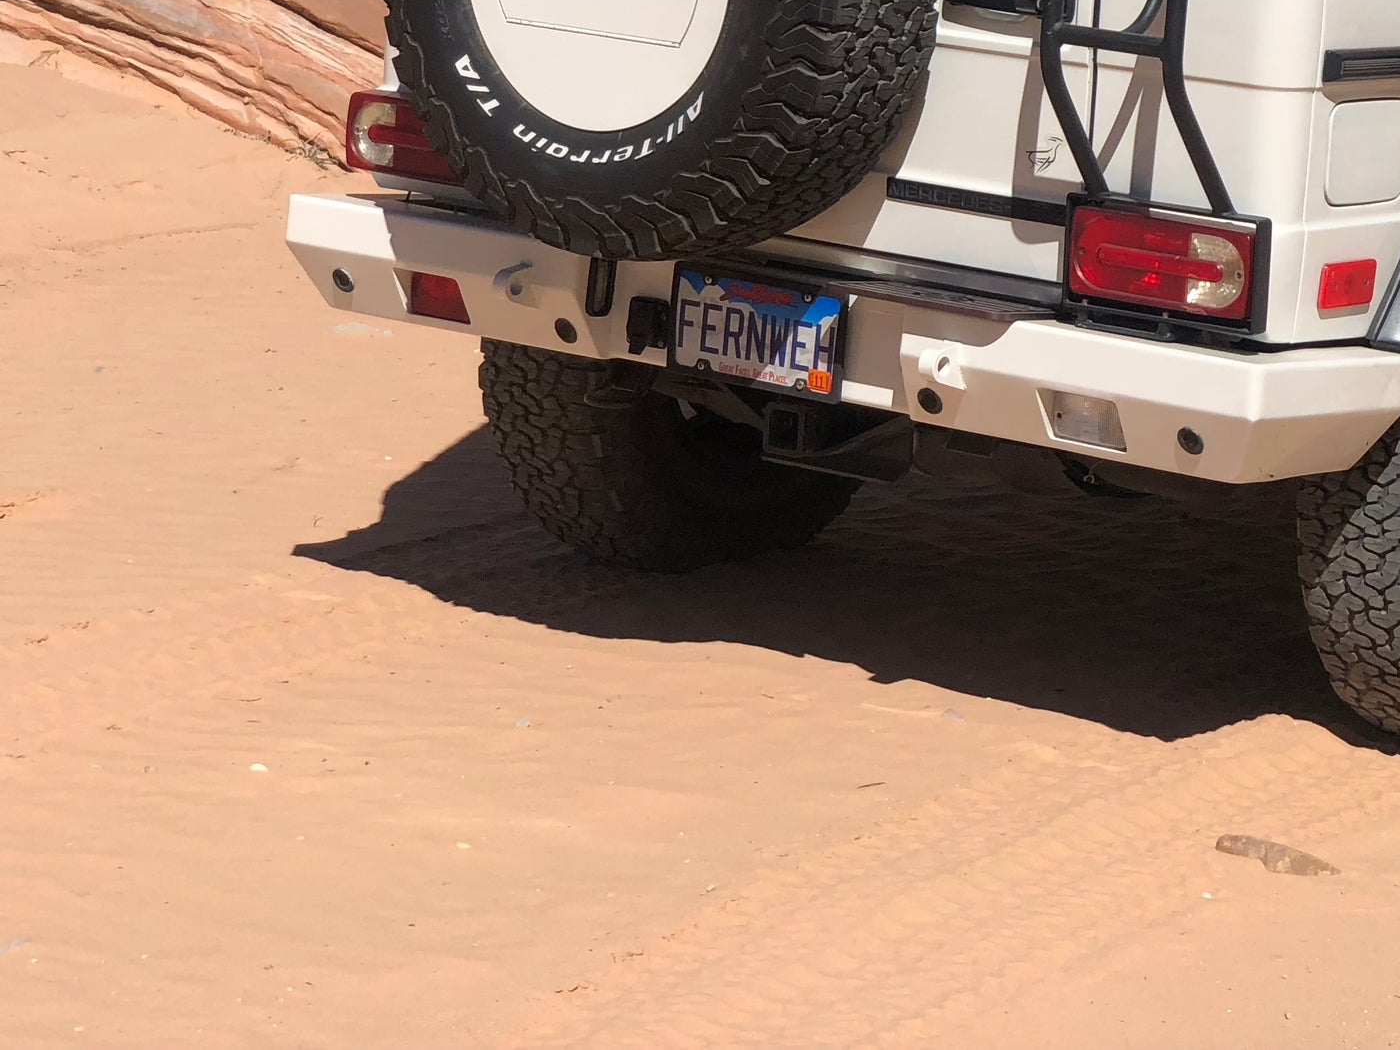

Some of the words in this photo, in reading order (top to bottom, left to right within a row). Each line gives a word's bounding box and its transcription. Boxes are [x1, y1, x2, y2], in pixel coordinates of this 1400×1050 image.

[454, 43, 500, 118] T/A
[512, 90, 705, 164] All-Terrain
[677, 298, 835, 373] FERNWEH
